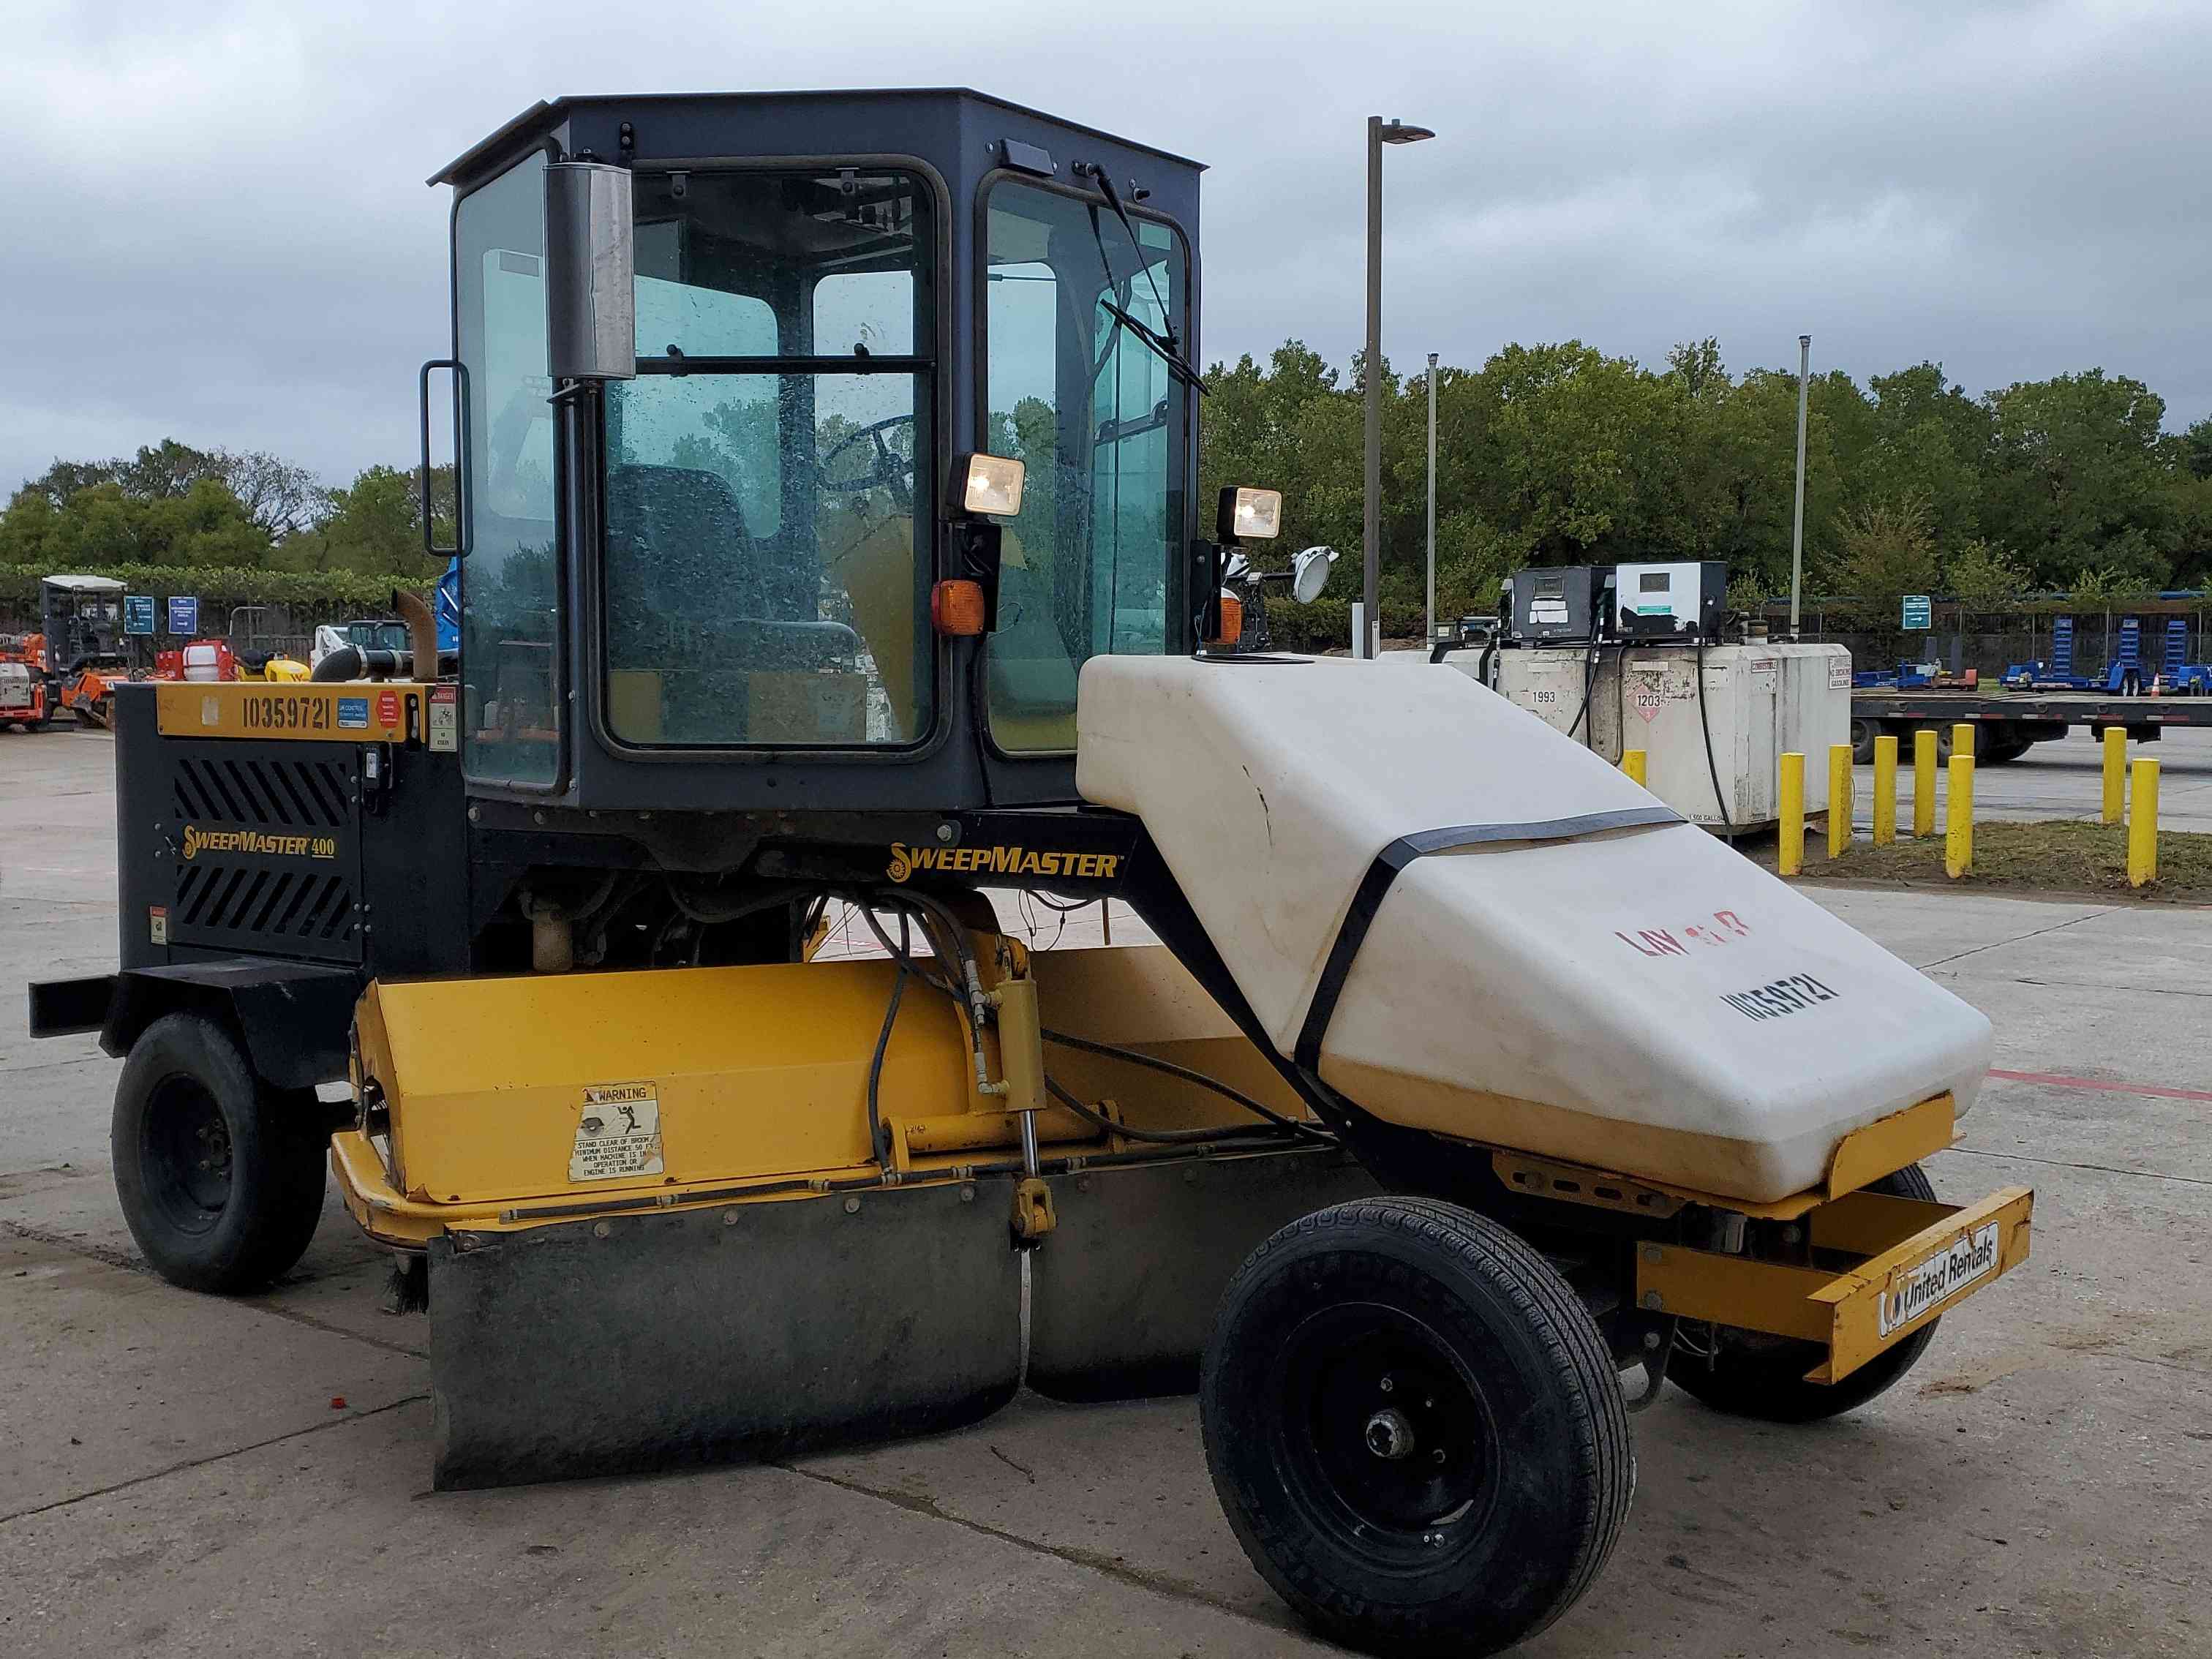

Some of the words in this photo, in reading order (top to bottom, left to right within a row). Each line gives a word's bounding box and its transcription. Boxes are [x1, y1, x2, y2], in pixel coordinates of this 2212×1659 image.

[1532, 691, 1556, 703] 1993
[1637, 694, 1660, 707] 1203
[242, 696, 330, 729] 10359721
[311, 838, 334, 855] 400
[598, 1087, 647, 1102] WARNING
[578, 1141, 597, 1149] STAND
[599, 1139, 618, 1147] CLEAR
[575, 1148, 601, 1156] MINIMUM
[603, 1146, 633, 1154] DISTANCE
[600, 1153, 625, 1161] MACHINE
[593, 1159, 627, 1168] OPERATION
[584, 1168, 606, 1176] ENGINE
[619, 1165, 644, 1173] RUNNING
[1904, 1260, 1946, 1311] United
